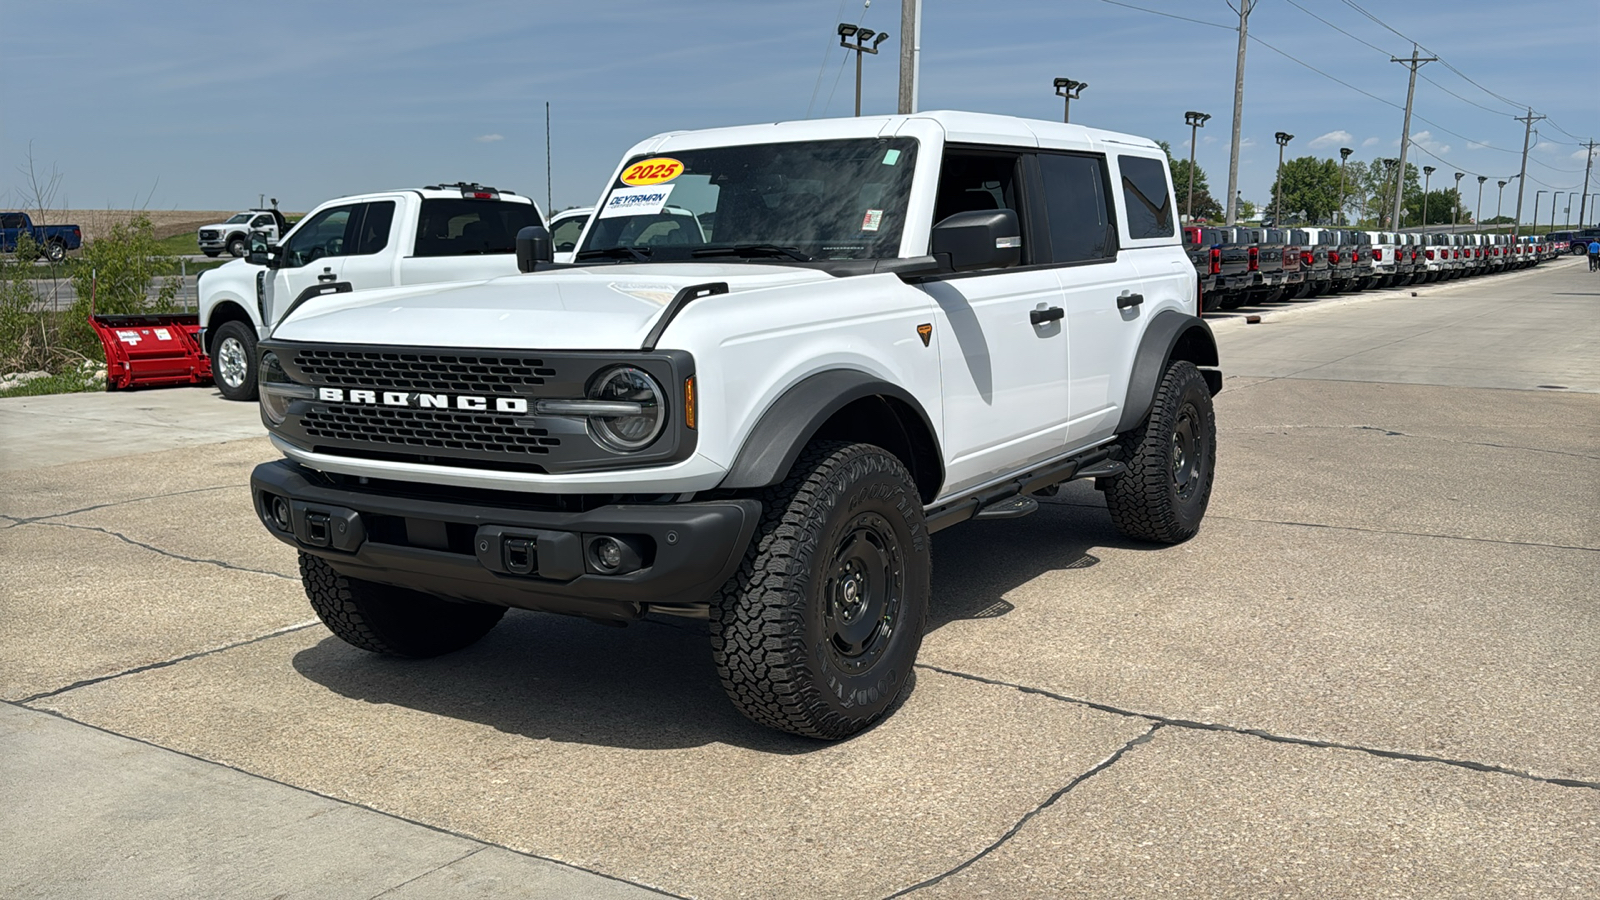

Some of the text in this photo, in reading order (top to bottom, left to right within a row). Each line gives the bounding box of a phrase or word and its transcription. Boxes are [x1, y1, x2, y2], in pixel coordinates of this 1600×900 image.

[626, 164, 679, 180] 2025
[609, 194, 666, 205] DEYARMAN
[319, 387, 528, 413] BRONCO
